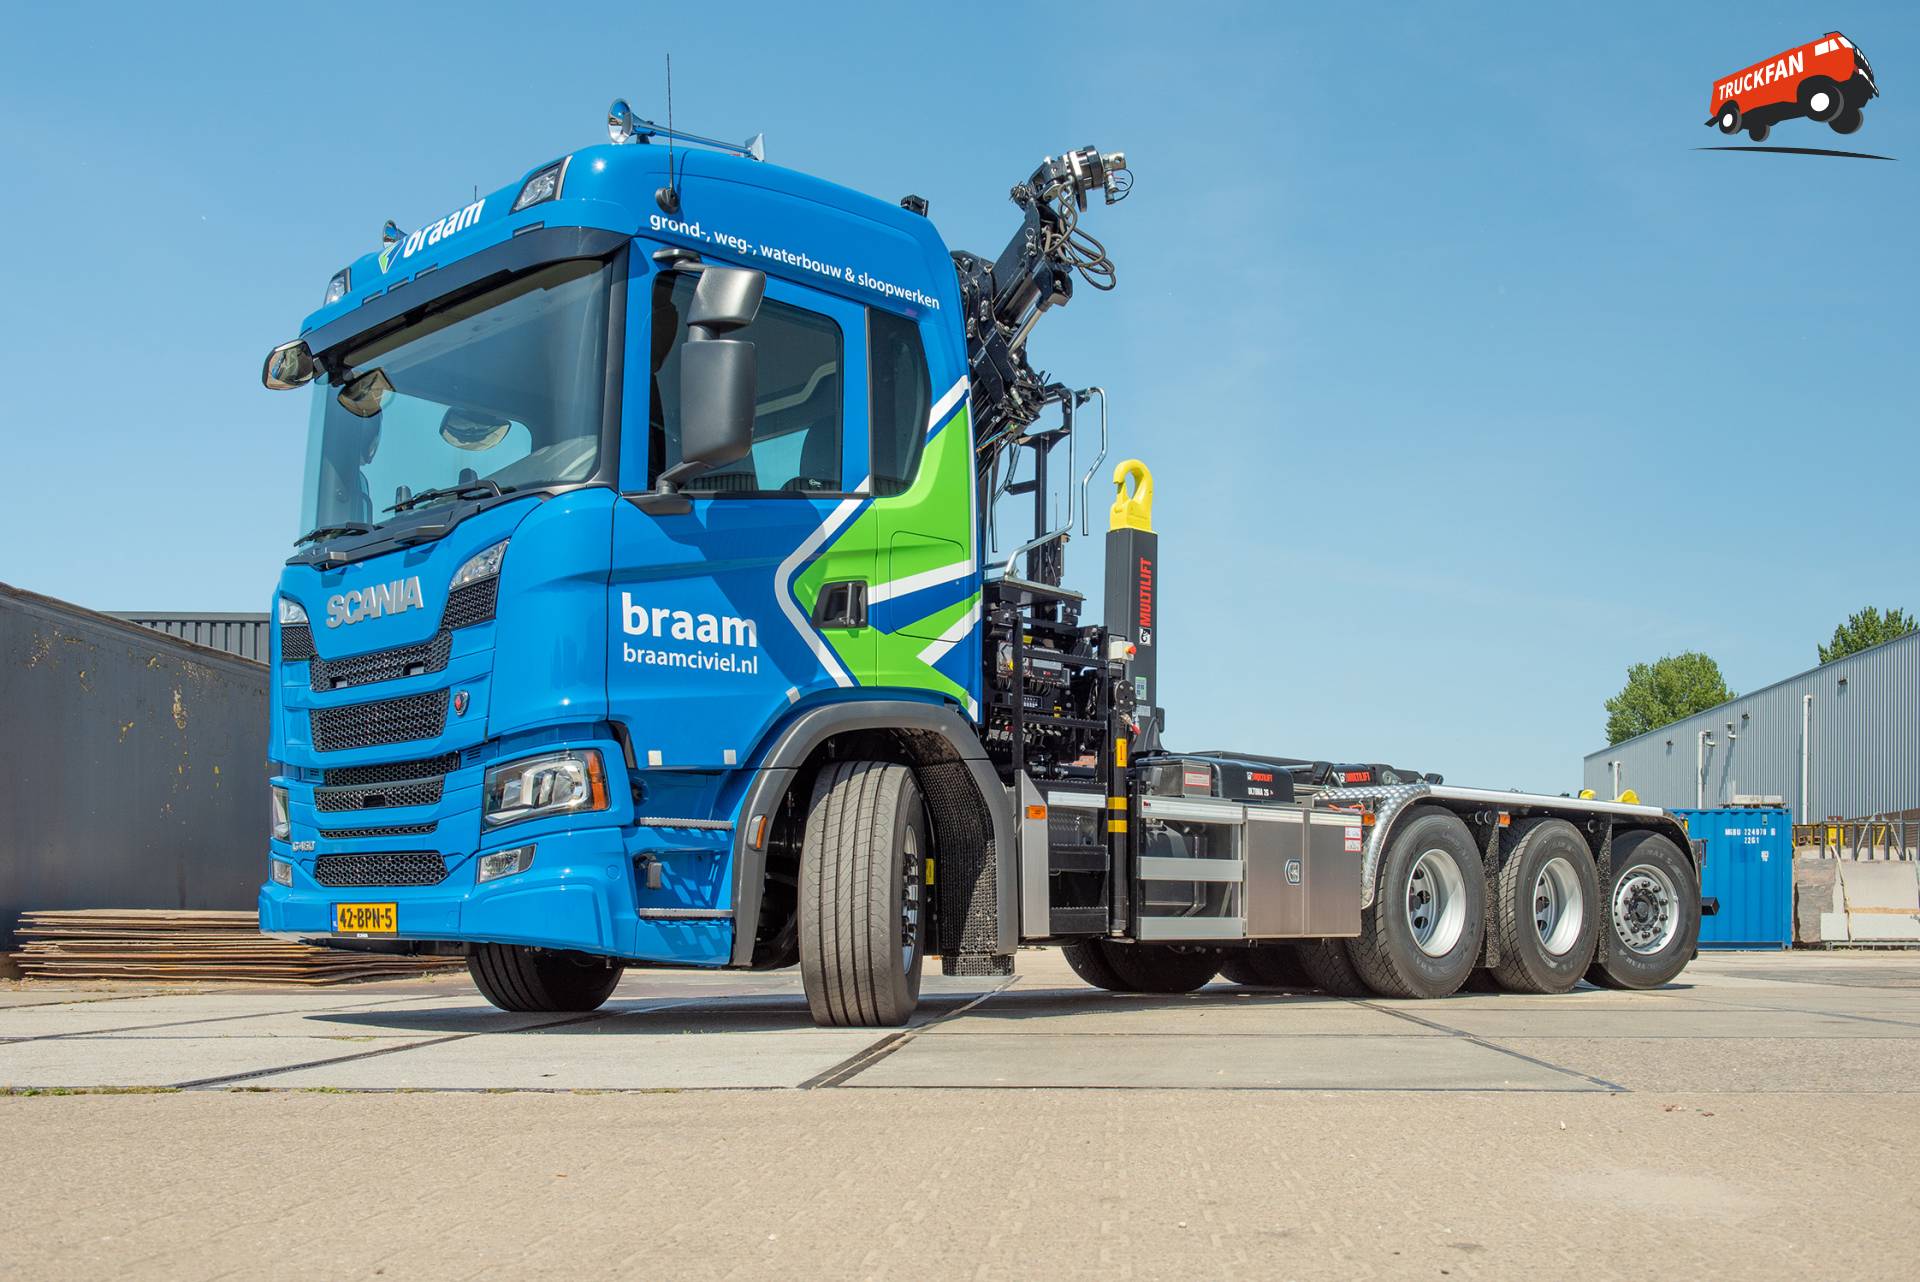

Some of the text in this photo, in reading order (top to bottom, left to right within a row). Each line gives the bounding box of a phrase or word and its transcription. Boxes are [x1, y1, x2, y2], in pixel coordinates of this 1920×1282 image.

[403, 199, 486, 258] braam
[650, 214, 940, 310] grond-, weg-, waterbouw & sloopwerken
[326, 575, 424, 628] SCANIA
[622, 591, 758, 648] braam
[1140, 557, 1152, 627] MULTILIFT
[623, 642, 758, 674] braamciviel.nl
[340, 907, 393, 929] 42-BPN-5
